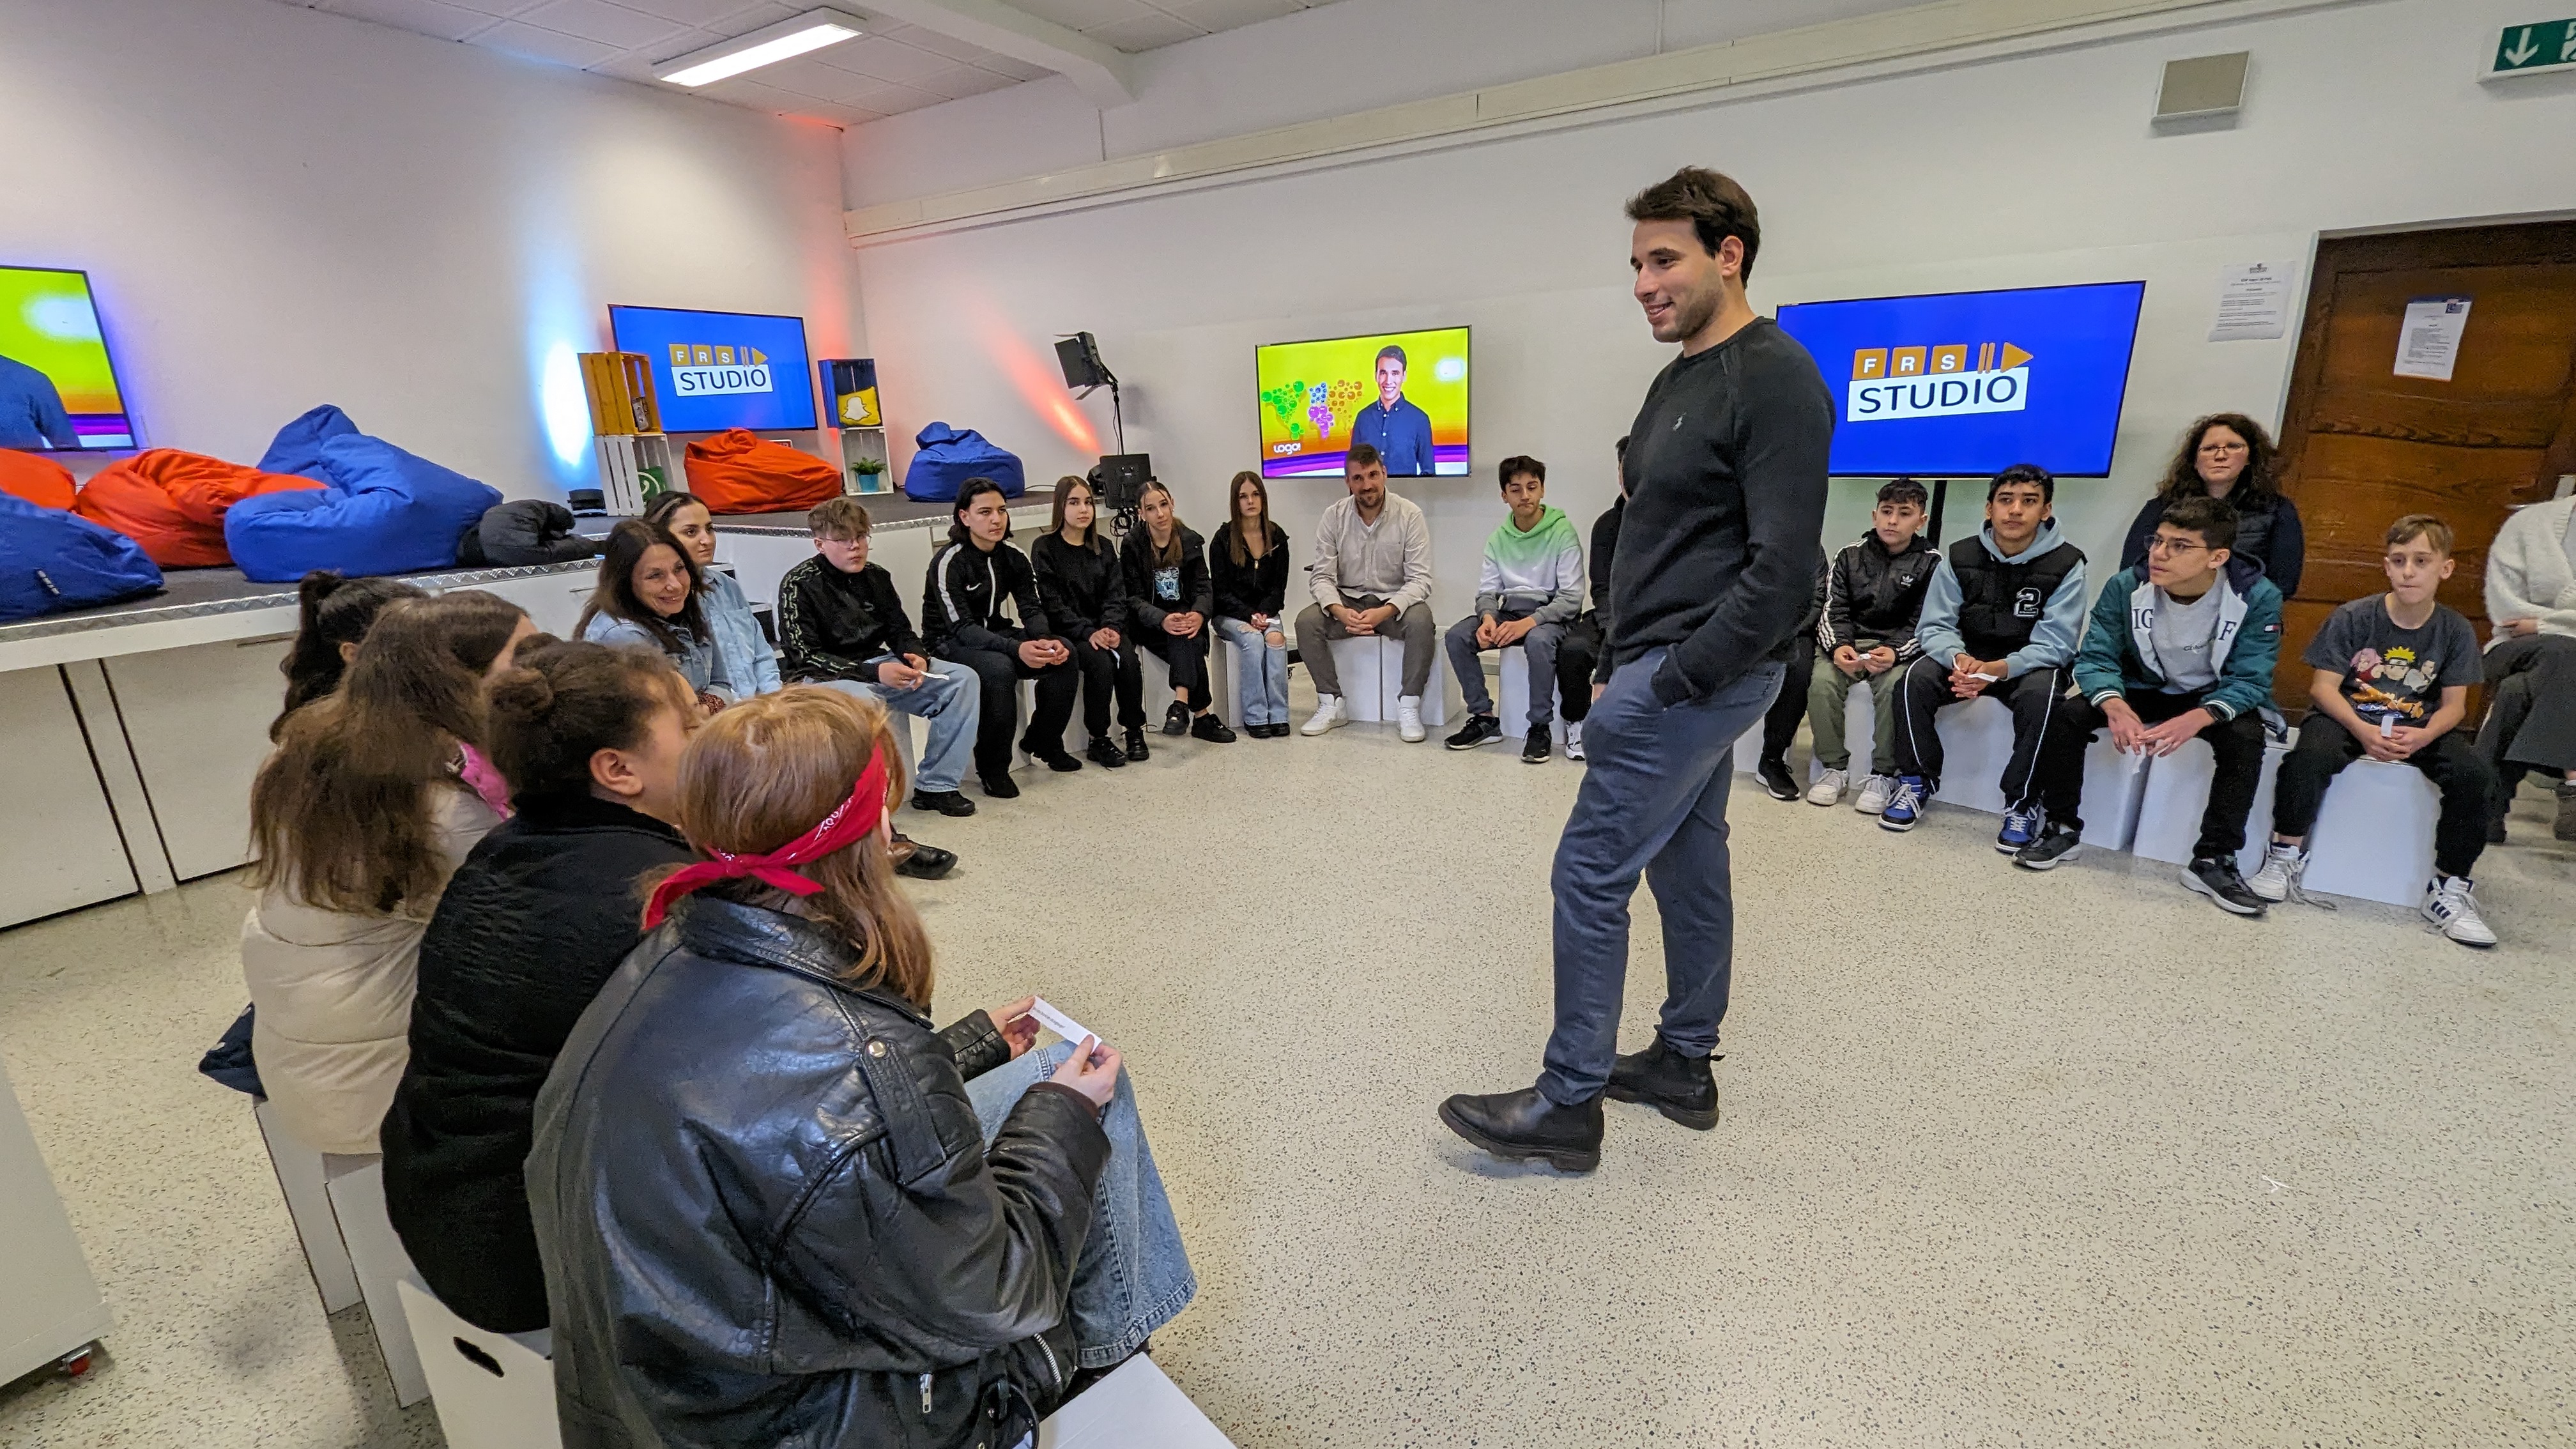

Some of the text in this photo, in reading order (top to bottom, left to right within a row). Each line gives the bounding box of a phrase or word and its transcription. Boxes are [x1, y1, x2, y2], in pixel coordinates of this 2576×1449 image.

[680, 369, 767, 391] STUDIO
[1859, 375, 2018, 413] STUDIO
[2013, 586, 2041, 618] 2
[2218, 620, 2237, 641] F
